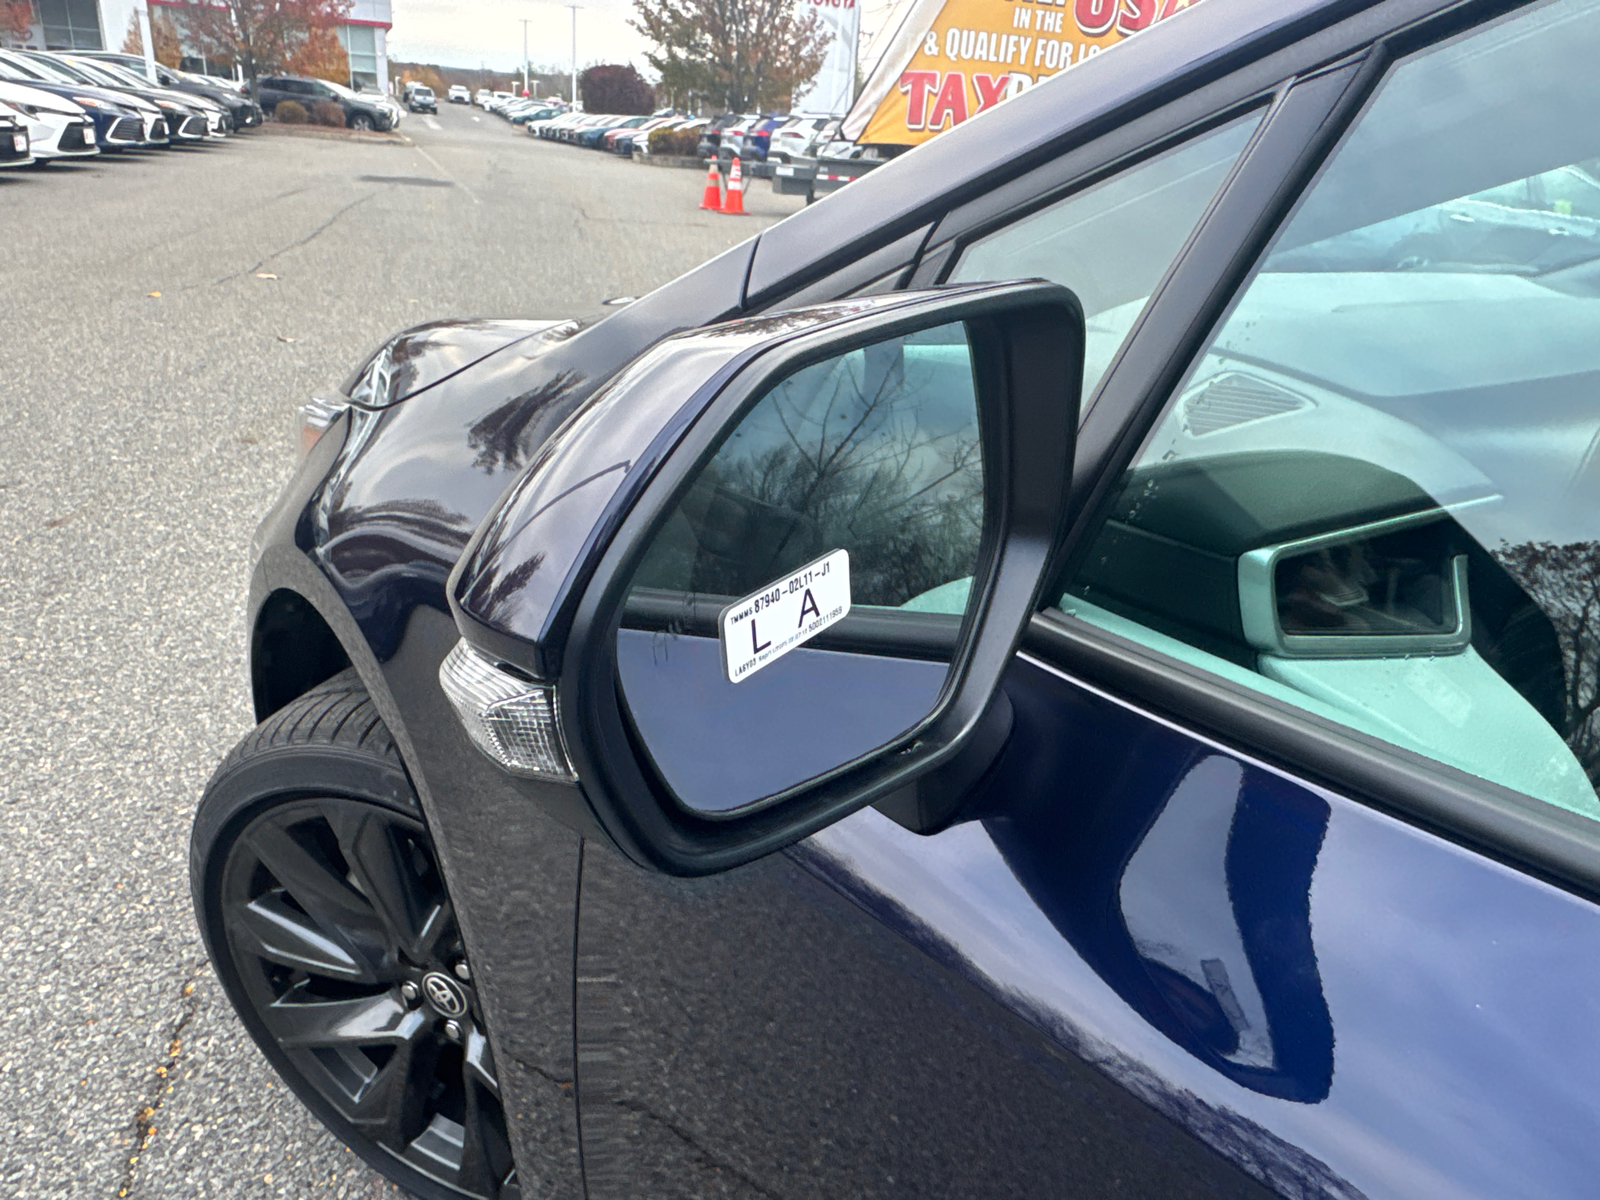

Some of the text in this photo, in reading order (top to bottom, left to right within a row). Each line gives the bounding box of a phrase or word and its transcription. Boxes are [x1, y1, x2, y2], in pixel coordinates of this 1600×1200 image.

[1013, 7, 1064, 33] IN THE
[924, 31, 940, 56] &
[945, 28, 1032, 66] QUALIFY
[1034, 38, 1073, 69] FOR
[754, 561, 830, 613] 87940-02L11-J1
[751, 588, 820, 655] L A
